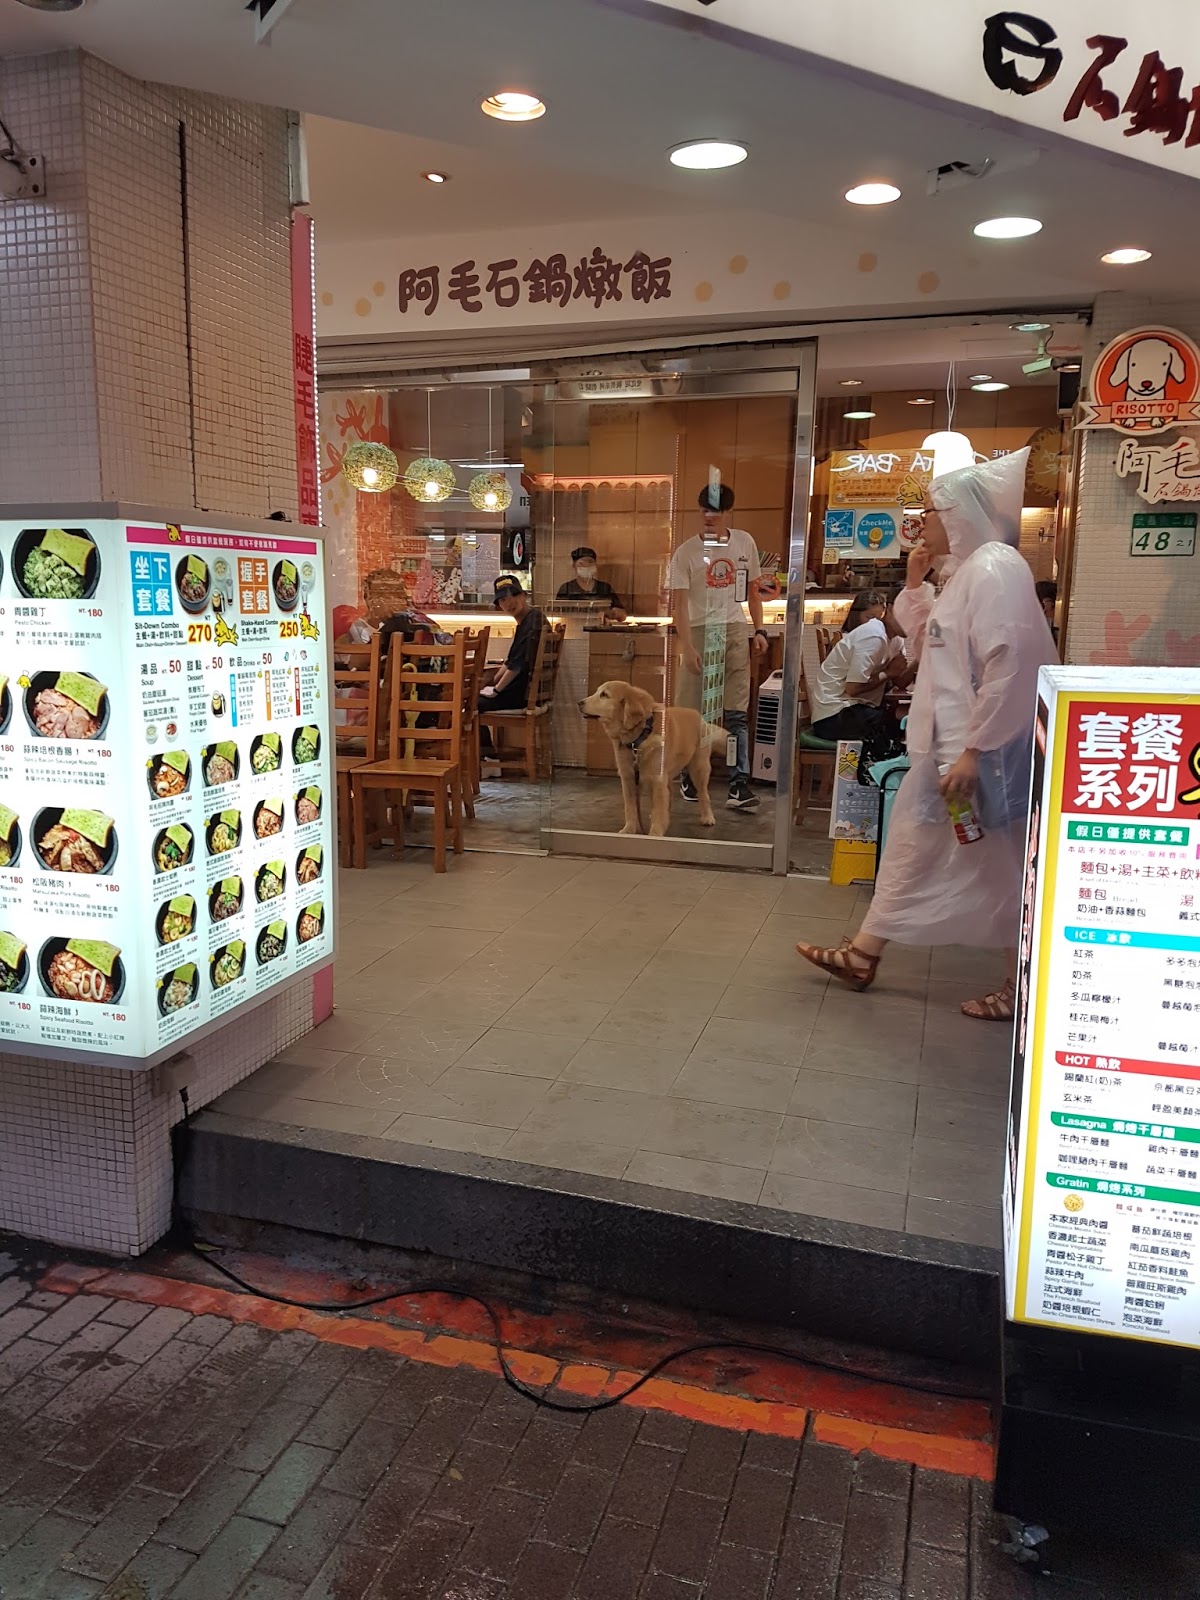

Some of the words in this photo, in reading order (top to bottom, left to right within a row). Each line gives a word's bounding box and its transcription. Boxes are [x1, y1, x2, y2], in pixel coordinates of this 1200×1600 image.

[1063, 34, 1200, 148] 石鍋
[399, 247, 672, 315] 阿毛石鍋燉飯
[1116, 403, 1174, 415] RISOTTO
[1121, 442, 1200, 493] 阿毛
[861, 519, 893, 527] CheckMe
[1135, 531, 1170, 551] 48
[135, 555, 168, 580] 坐下
[240, 561, 267, 582] 握手
[136, 588, 171, 612] 套餐
[241, 589, 268, 611] 套餐
[87, 608, 103, 617] 180
[188, 624, 212, 642] 270
[280, 621, 299, 638] 250
[212, 656, 223, 669] 50
[262, 652, 273, 665] 50
[169, 659, 182, 673] 50
[1077, 712, 1184, 763] 套餐
[96, 749, 112, 758] 180
[1073, 763, 1179, 812] 系列
[9, 876, 24, 884] 180
[104, 884, 120, 892] 180
[1078, 887, 1107, 901] 麵包
[1180, 894, 1194, 907] 湯
[1074, 930, 1097, 941] ICE
[1073, 949, 1094, 959] 紅茶
[1166, 956, 1200, 968] 多多泡
[1071, 970, 1092, 980] 奶茶
[17, 1002, 32, 1011] 180
[111, 1013, 126, 1021] 180
[1067, 1032, 1097, 1044] 芒果汁
[1064, 1054, 1091, 1066] HOT
[1063, 1093, 1093, 1104] 玄米茶
[1060, 1115, 1107, 1130] Lasagna
[1056, 1175, 1090, 1189] Gratin
[1044, 1275, 1061, 1284] Spicy
[1061, 1277, 1079, 1286] Garlic
[1043, 1283, 1084, 1297] 法式海鮮
[1154, 1291, 1180, 1301] Chicken
[1054, 1294, 1076, 1303] French
[1076, 1297, 1101, 1306] Seafood
[1041, 1309, 1058, 1317] Garlic
[1058, 1312, 1077, 1320] Cream
[1077, 1315, 1095, 1323] Bacon
[1095, 1318, 1116, 1327] Shrimp
[1122, 1312, 1164, 1327] 泡菜海鮮
[1122, 1323, 1145, 1331] Kimchi
[1145, 1325, 1171, 1335] Seafood
